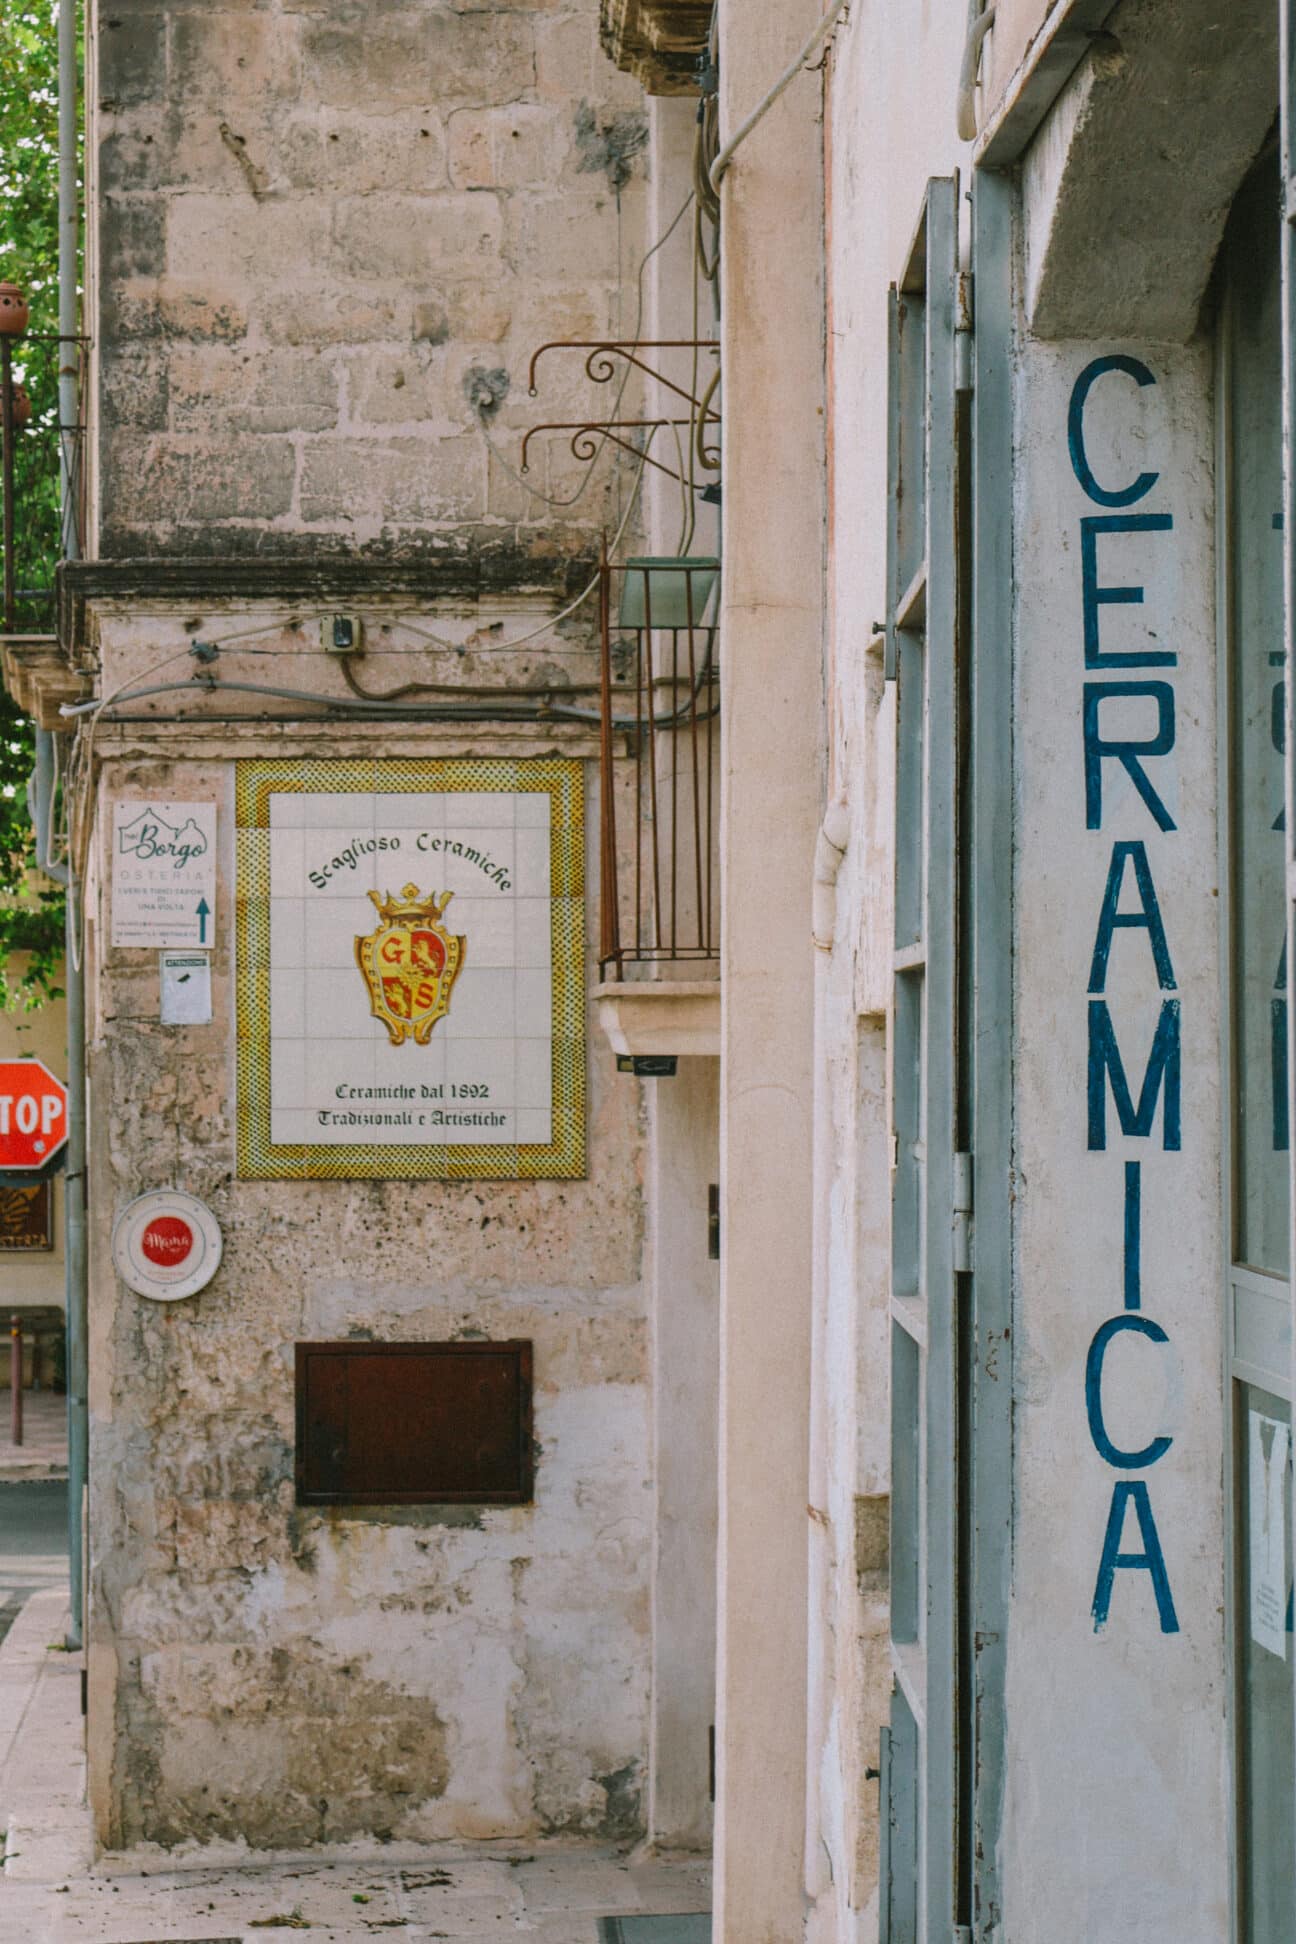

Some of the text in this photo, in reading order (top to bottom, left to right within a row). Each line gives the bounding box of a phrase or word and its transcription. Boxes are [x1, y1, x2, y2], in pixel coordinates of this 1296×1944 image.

[135, 824, 203, 869] Borgo
[308, 832, 512, 891] Scaglioso Ceramiche
[120, 870, 203, 881] OSTERIA
[381, 937, 404, 964] G
[415, 982, 433, 1009] S
[1067, 354, 1182, 1634] CERAMICA
[335, 1083, 489, 1099] Ceramiche dal 1892
[317, 1110, 507, 1126] Tradizionali e Artistiche
